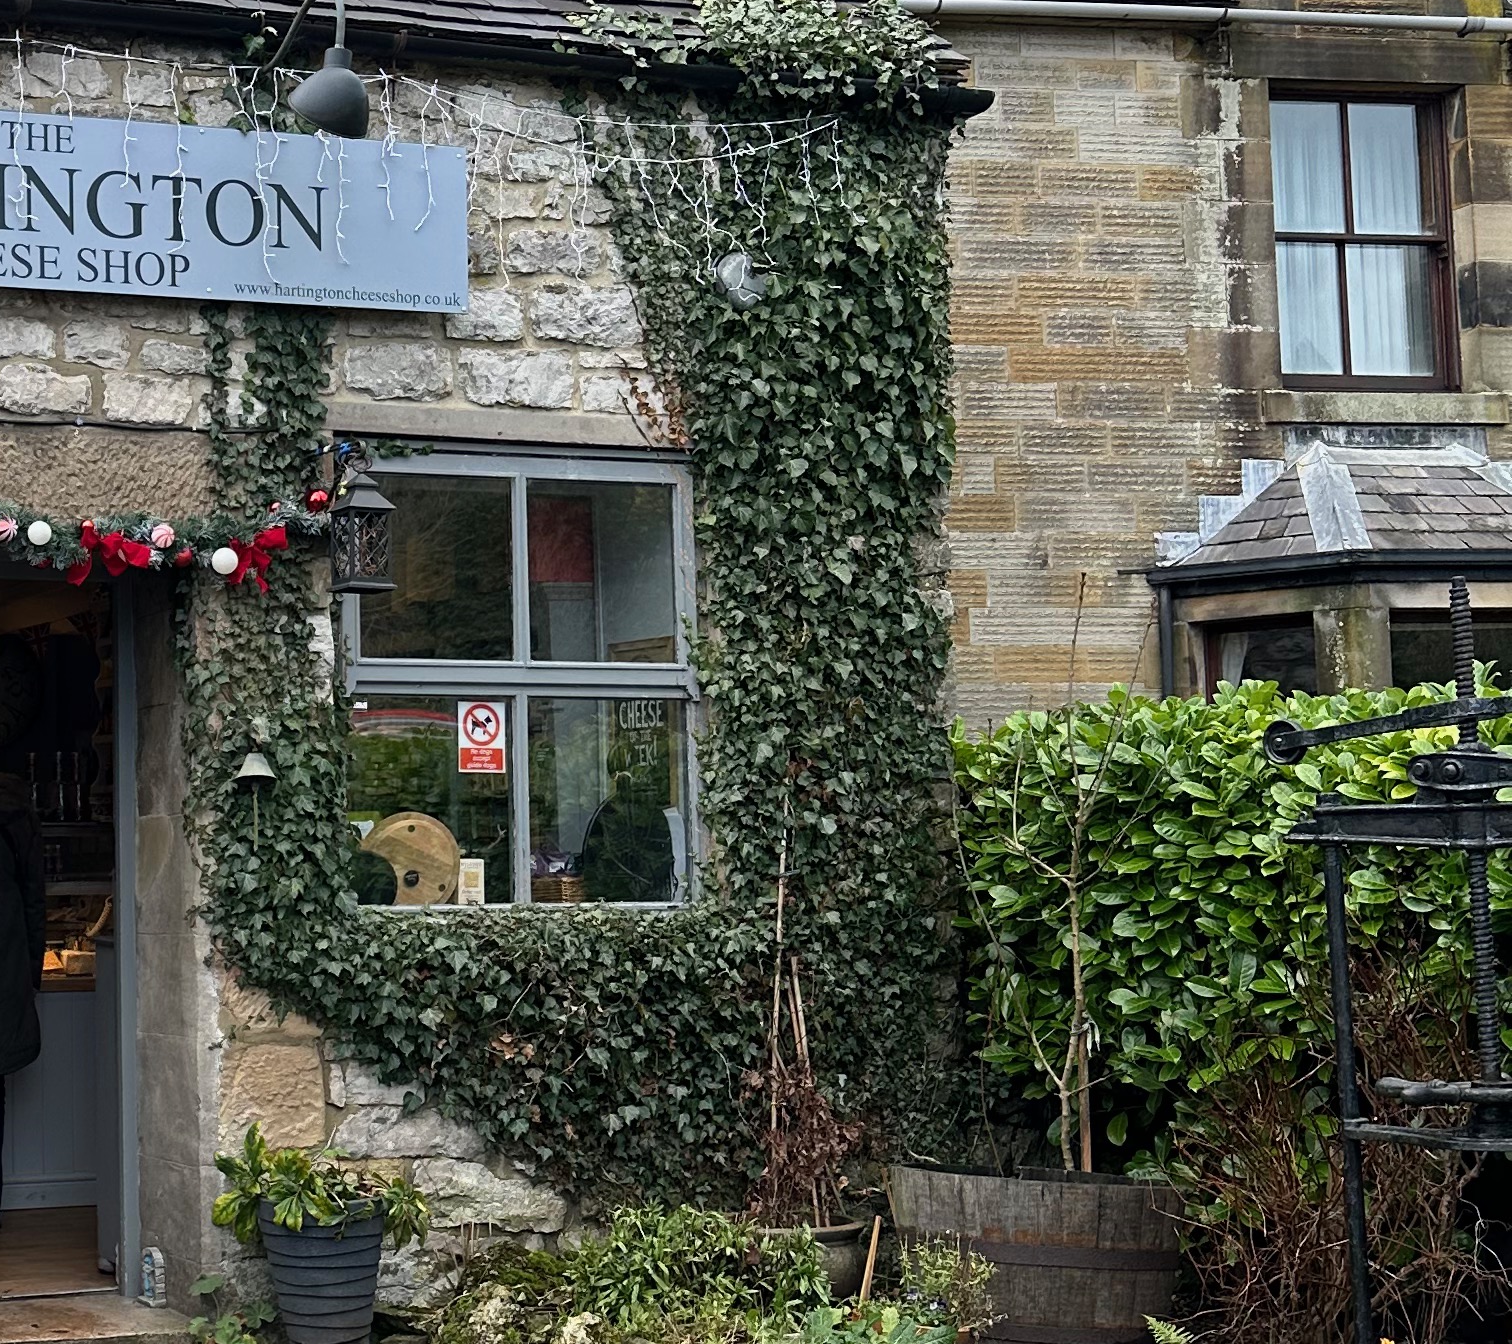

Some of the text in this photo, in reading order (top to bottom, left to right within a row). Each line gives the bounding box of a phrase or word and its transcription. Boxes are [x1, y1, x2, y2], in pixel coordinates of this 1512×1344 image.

[1, 120, 76, 154] THE
[77, 247, 190, 288] SHOP
[619, 700, 664, 729] CHEESE
